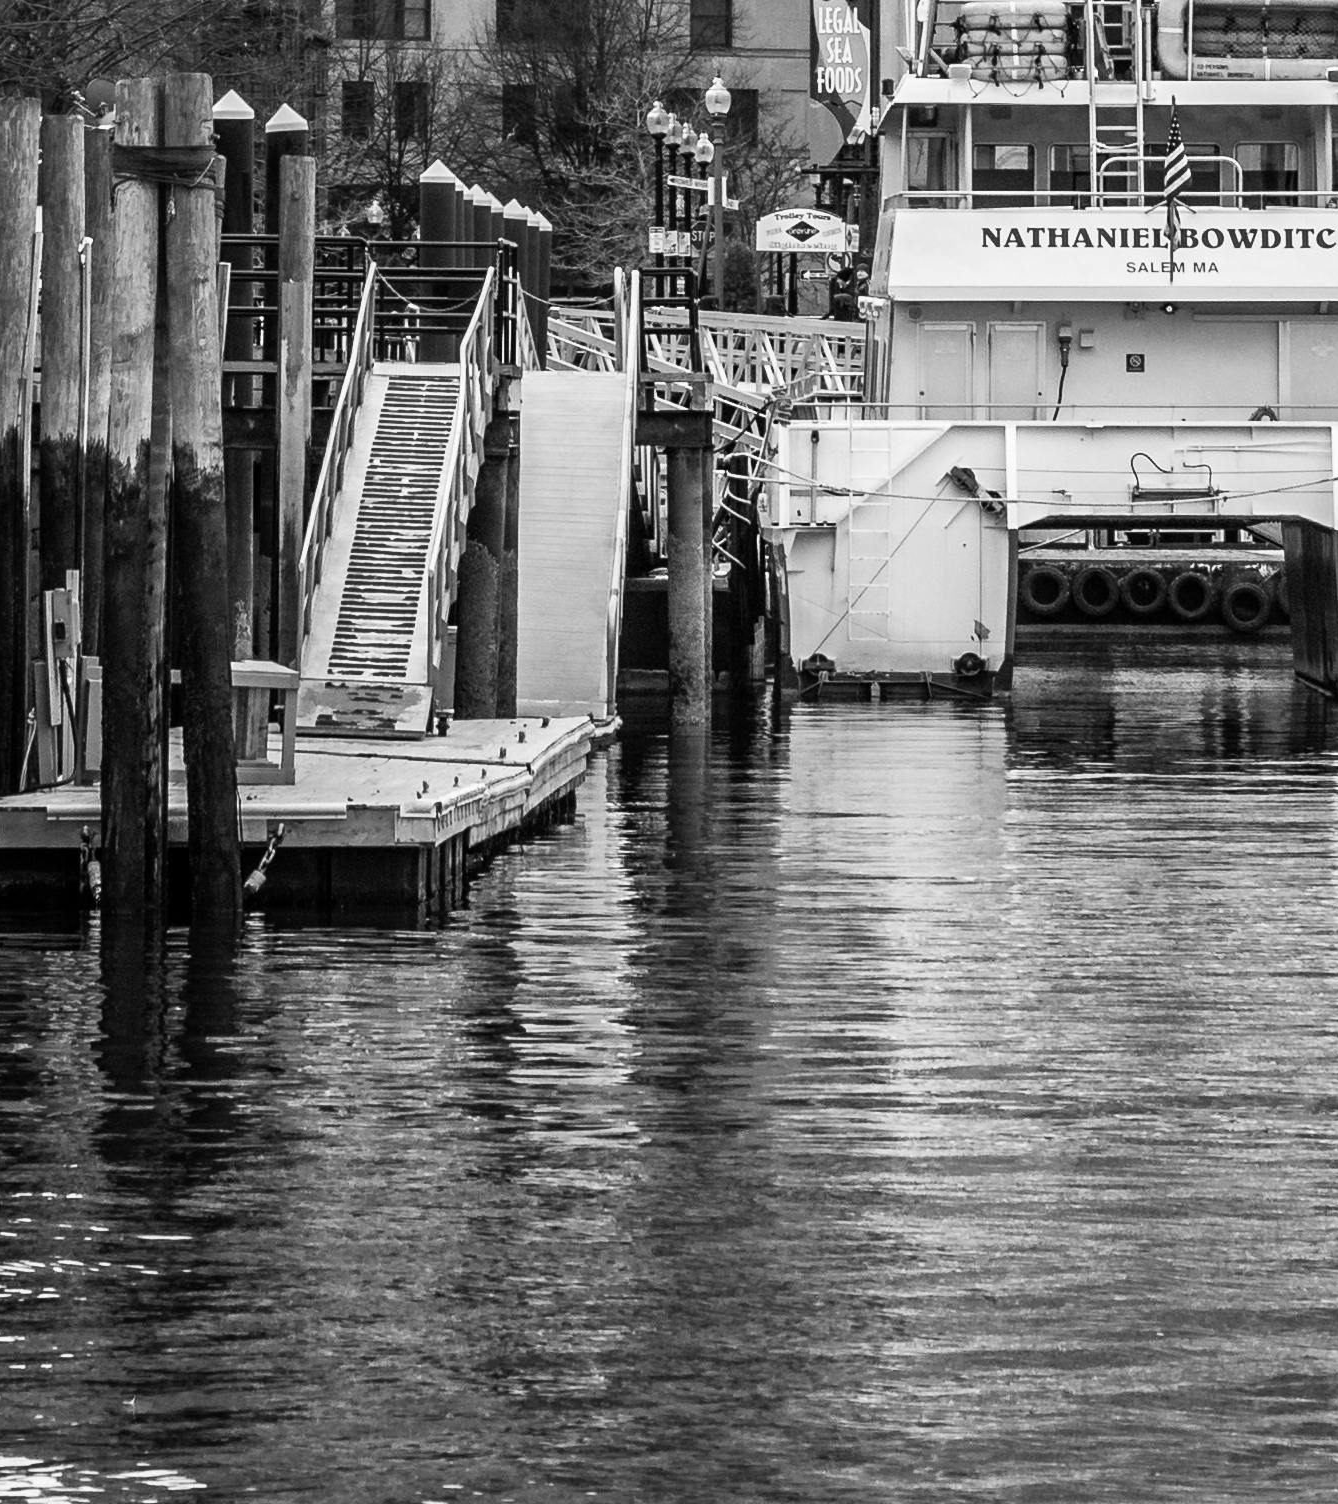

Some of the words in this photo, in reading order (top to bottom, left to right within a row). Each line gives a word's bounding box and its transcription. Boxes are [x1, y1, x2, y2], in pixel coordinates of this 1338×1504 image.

[818, 6, 861, 34] LEGAL
[826, 37, 853, 64] SEA
[817, 66, 862, 94] FOODS
[775, 213, 805, 221] Trolley
[692, 231, 715, 242] STP
[981, 227, 1171, 249] NATHANIEL
[1126, 261, 1186, 273] SALEM
[1193, 261, 1219, 273] MA
